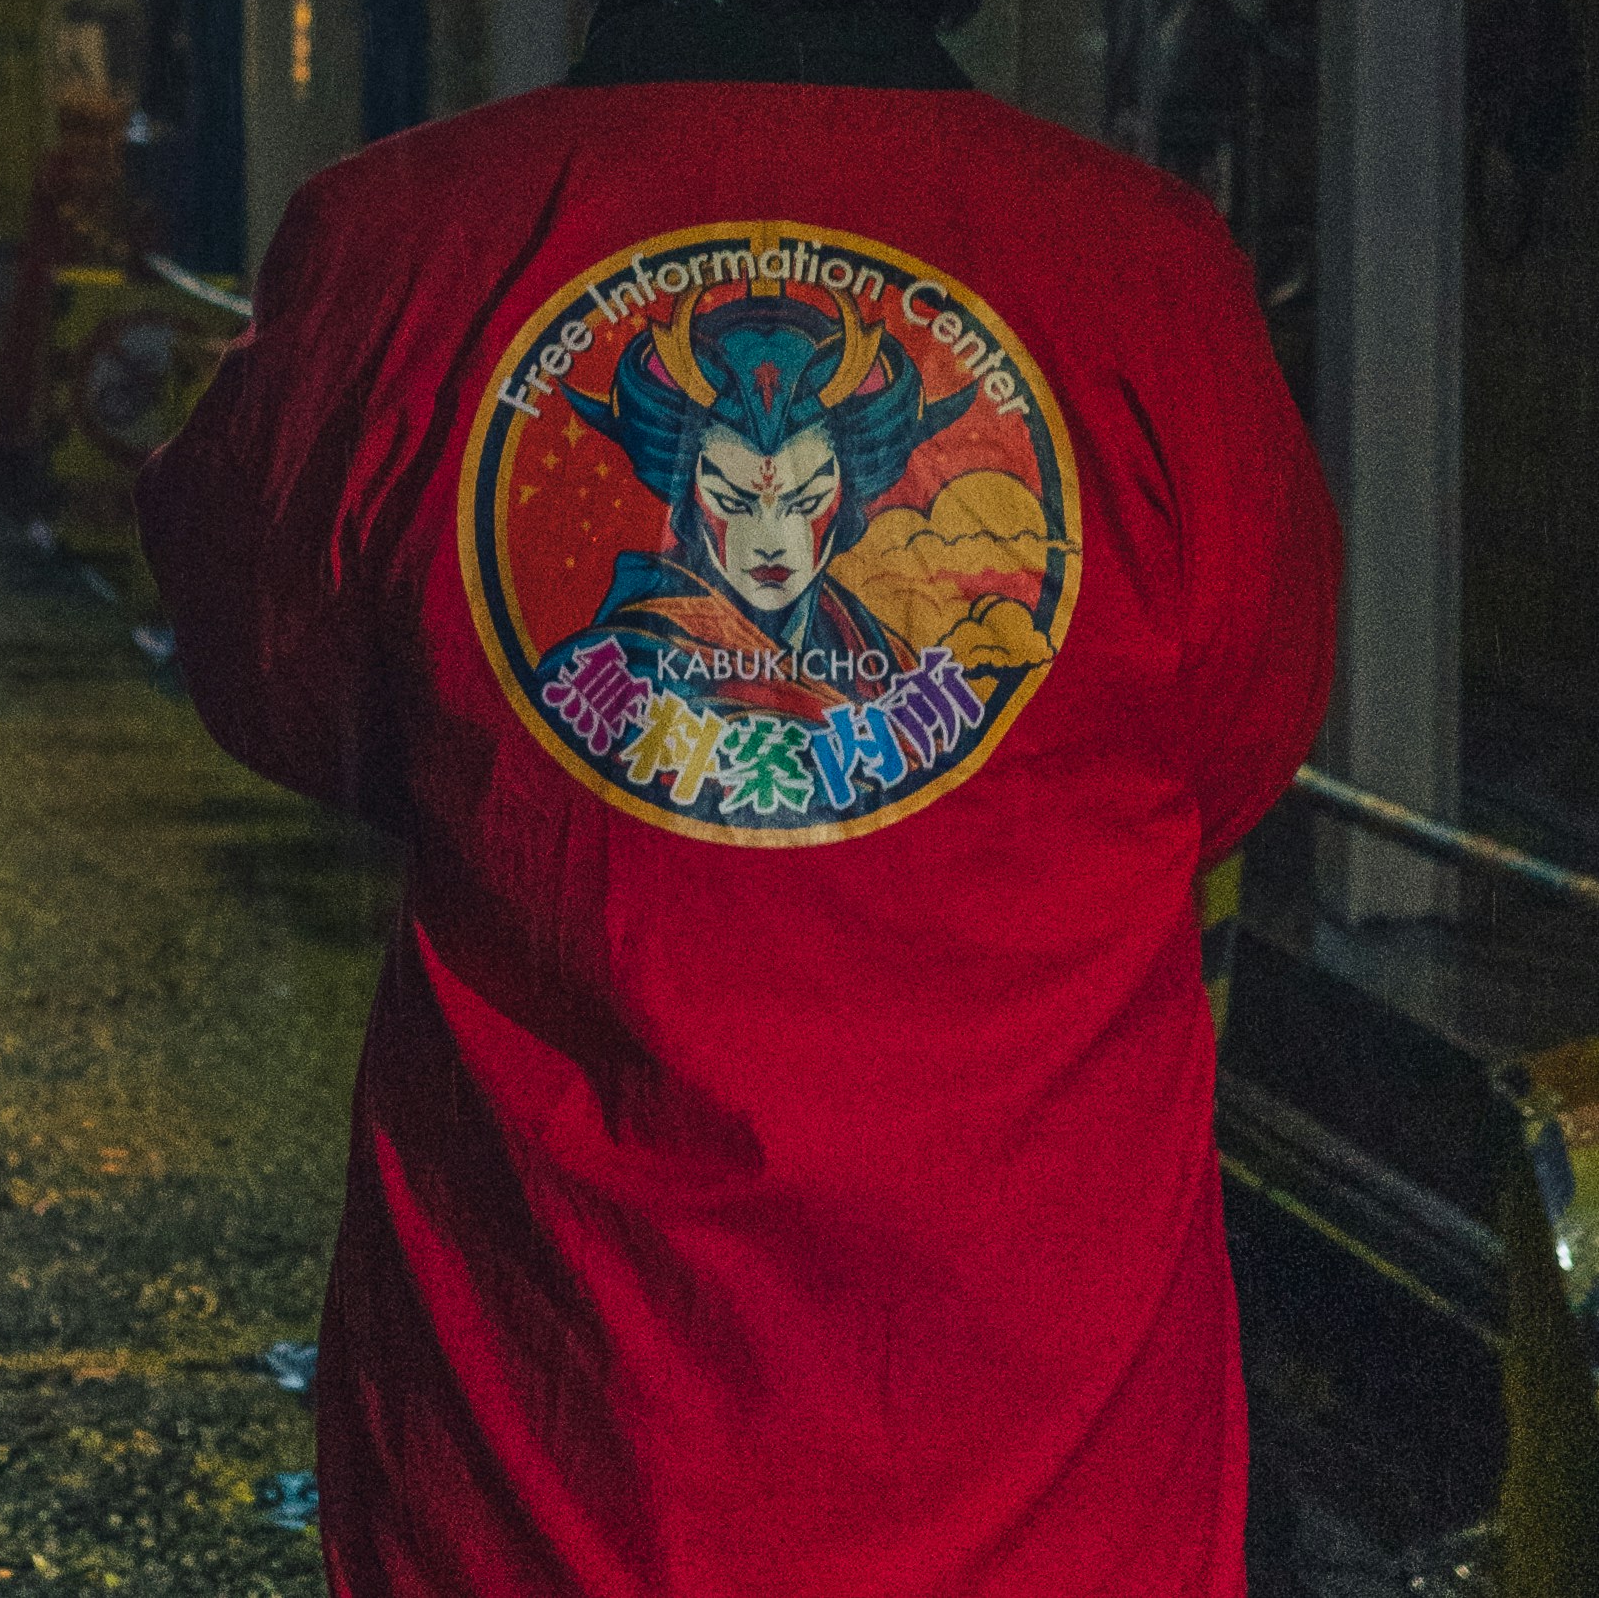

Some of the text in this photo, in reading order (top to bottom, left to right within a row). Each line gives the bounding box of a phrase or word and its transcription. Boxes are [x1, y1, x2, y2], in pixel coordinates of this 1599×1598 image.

[497, 239, 1031, 418] Free Information Center
[541, 635, 985, 816] 無料案内所
[656, 647, 890, 684] KABUKICHO
